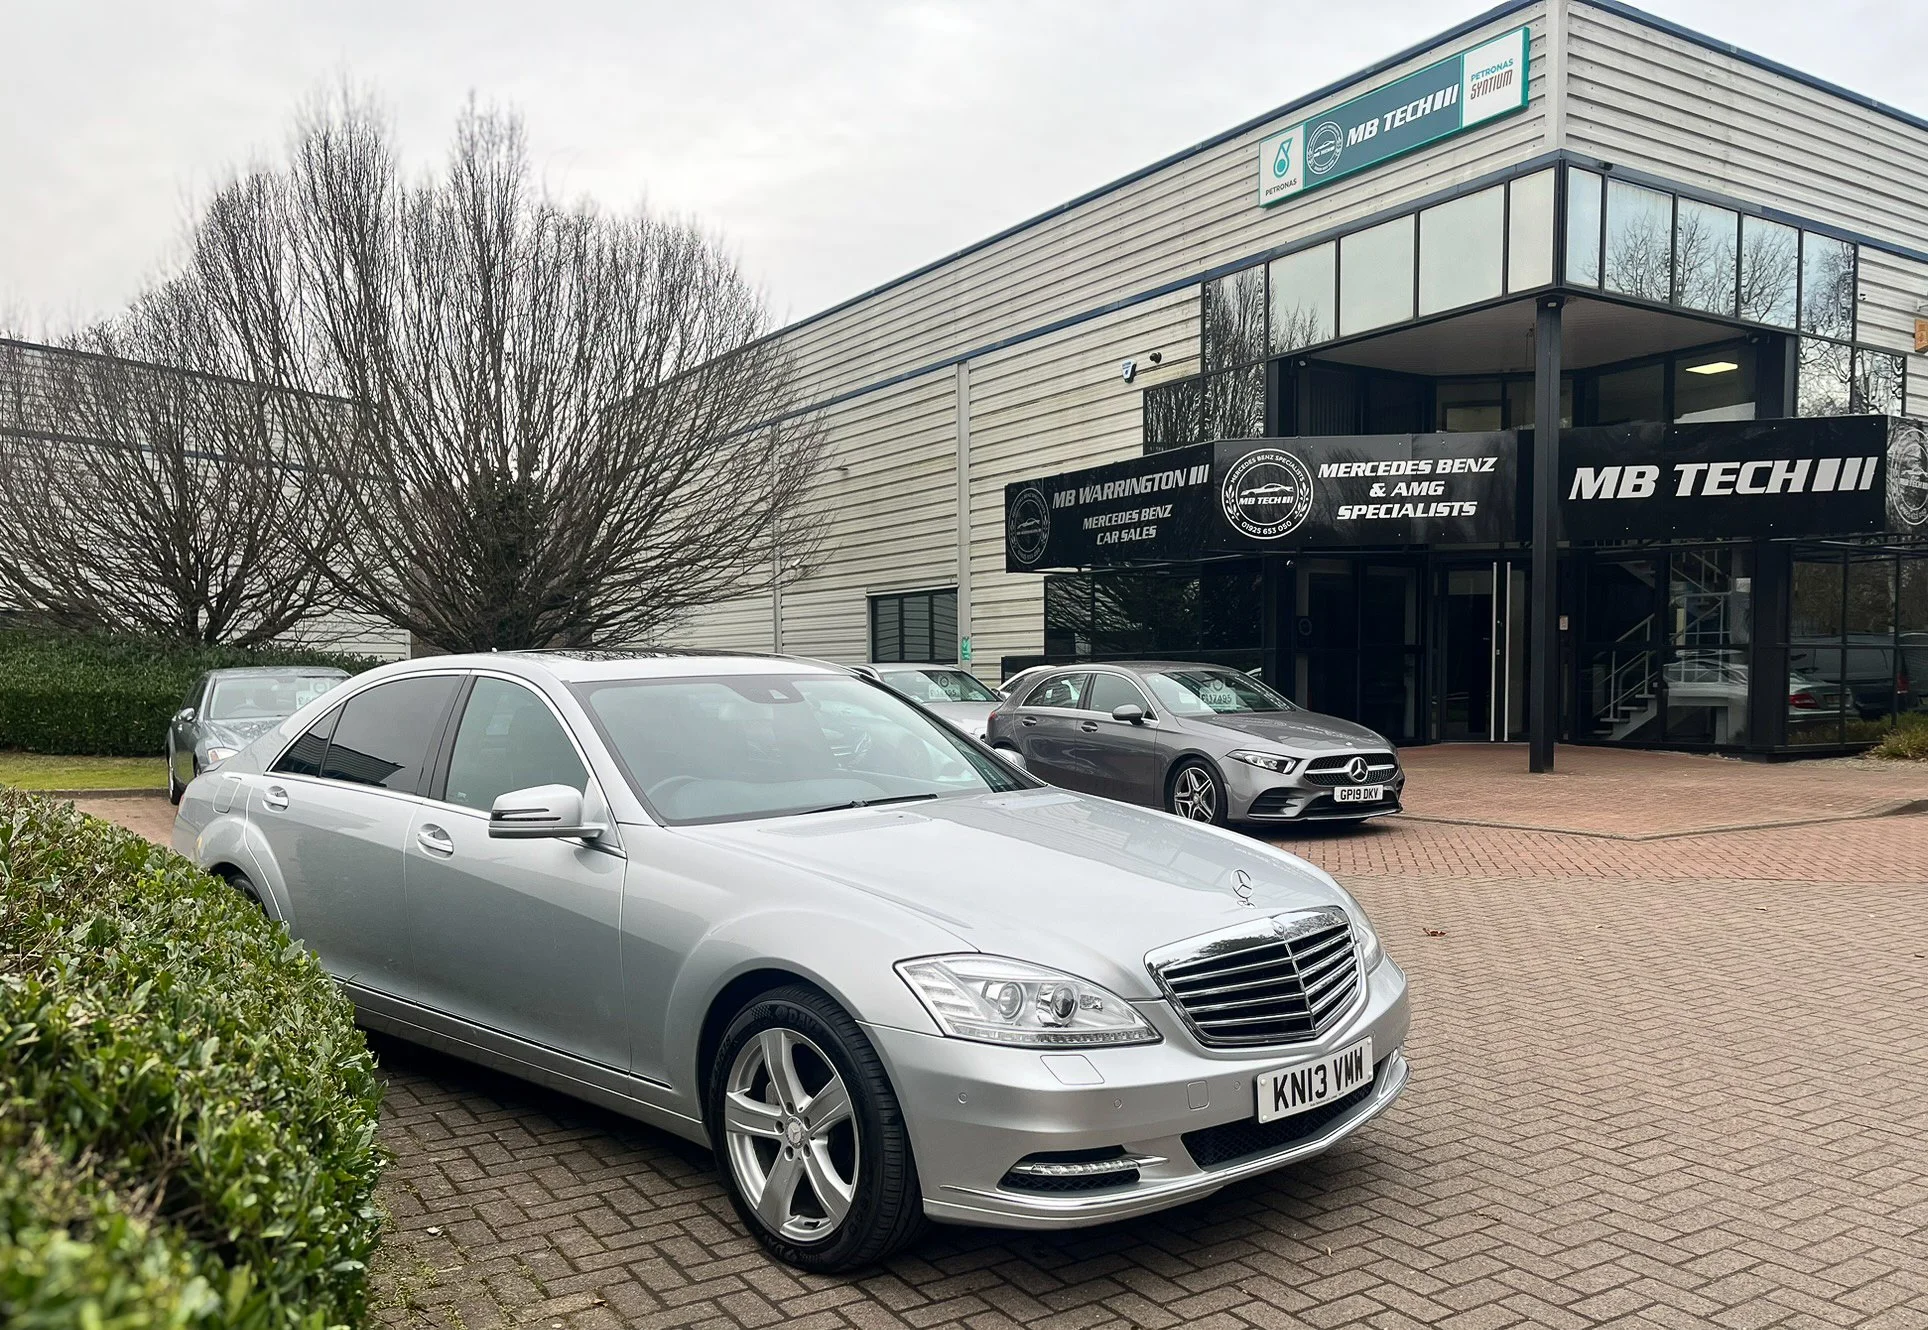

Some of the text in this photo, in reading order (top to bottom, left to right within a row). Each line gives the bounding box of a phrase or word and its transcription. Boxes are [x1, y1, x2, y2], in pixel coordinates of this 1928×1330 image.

[1470, 58, 1514, 82] PETRONAS
[1470, 69, 1513, 100] SYNTIUM
[1346, 118, 1379, 147] MB
[1265, 178, 1298, 196] PETRONAS
[1230, 454, 1305, 483] MERCEDES BENZ SPECIALISTS
[1317, 457, 1498, 478] MERCEDES BENZ
[1052, 489, 1075, 509] MB
[1079, 467, 1187, 505] WARRINGTON
[1369, 480, 1445, 498] & AMG
[1567, 464, 1660, 500] MB
[1239, 497, 1256, 505] MB
[1336, 501, 1478, 520] SPECIALISTS
[1082, 504, 1173, 531] MERCEDES BENZ
[1241, 521, 1261, 534] 01925
[1277, 520, 1292, 532] 050
[1096, 525, 1157, 545] CAR SALES
[1340, 787, 1379, 801] GP19 DKV
[1273, 1046, 1363, 1112] KN13 VMW
